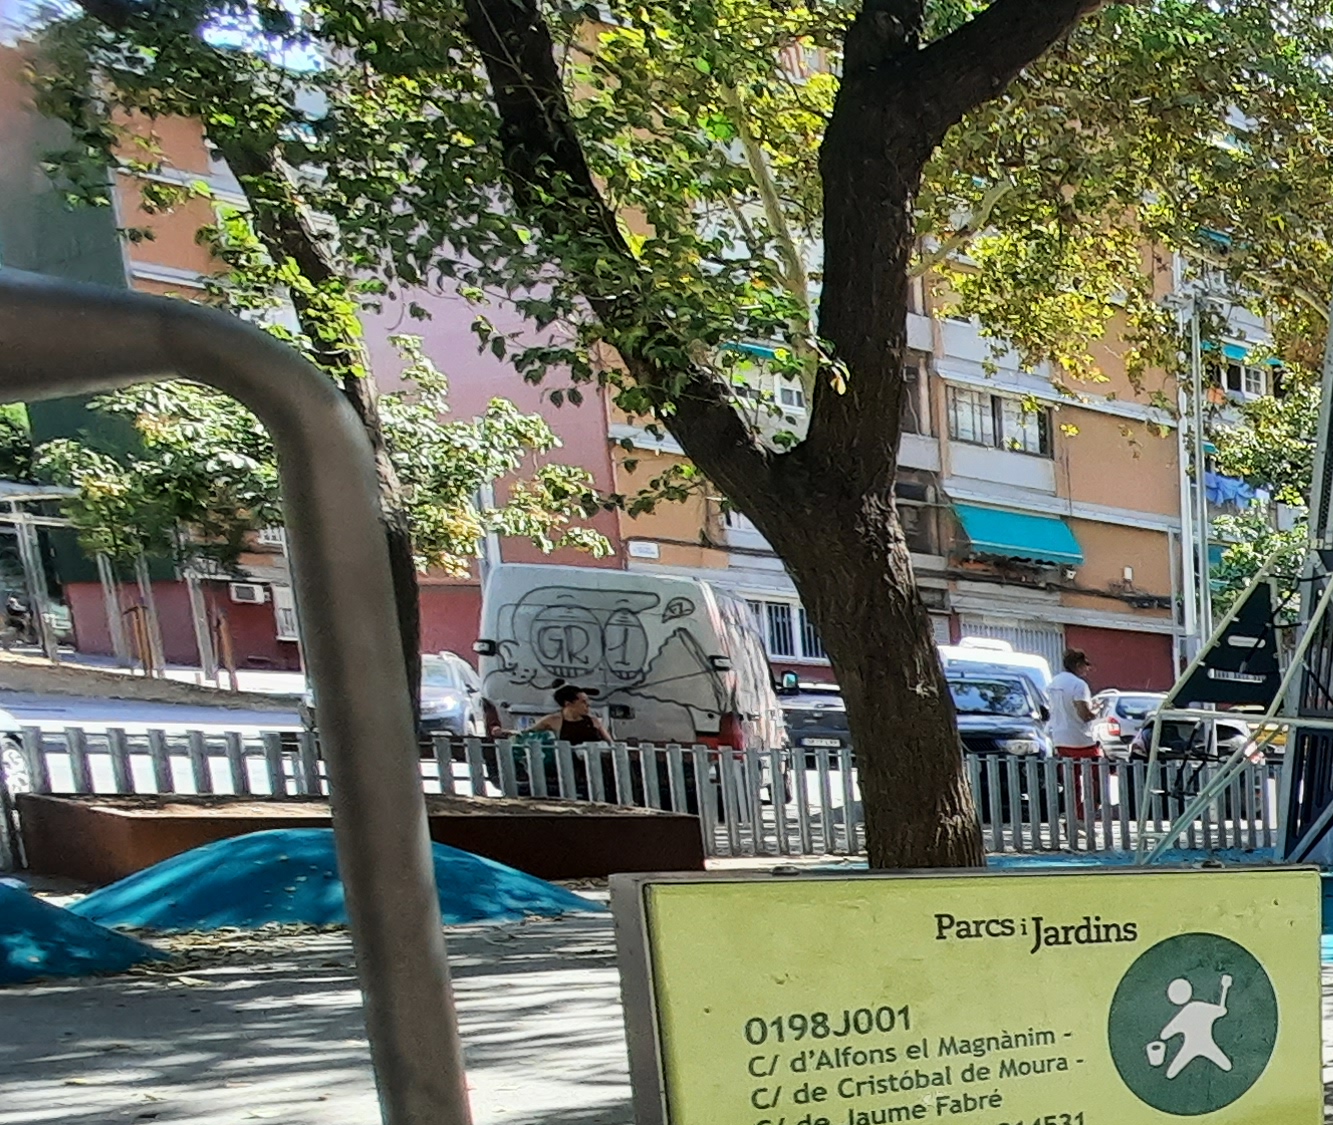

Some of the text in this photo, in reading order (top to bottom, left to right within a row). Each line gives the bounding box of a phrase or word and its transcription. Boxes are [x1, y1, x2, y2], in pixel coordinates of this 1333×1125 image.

[933, 913, 1138, 955] Parcs i Jardins
[744, 1004, 911, 1046] 0198J001
[747, 1053, 781, 1078] C/
[789, 1045, 898, 1074] d'Alfons
[905, 1037, 929, 1060] el
[937, 1027, 1056, 1058] Magnànim
[750, 1085, 783, 1110] C/
[792, 1082, 828, 1105] de
[837, 1065, 953, 1099] Cristóbal
[960, 1062, 991, 1084] de
[998, 1056, 1069, 1079] Moura
[935, 1092, 1003, 1117] Fabré
